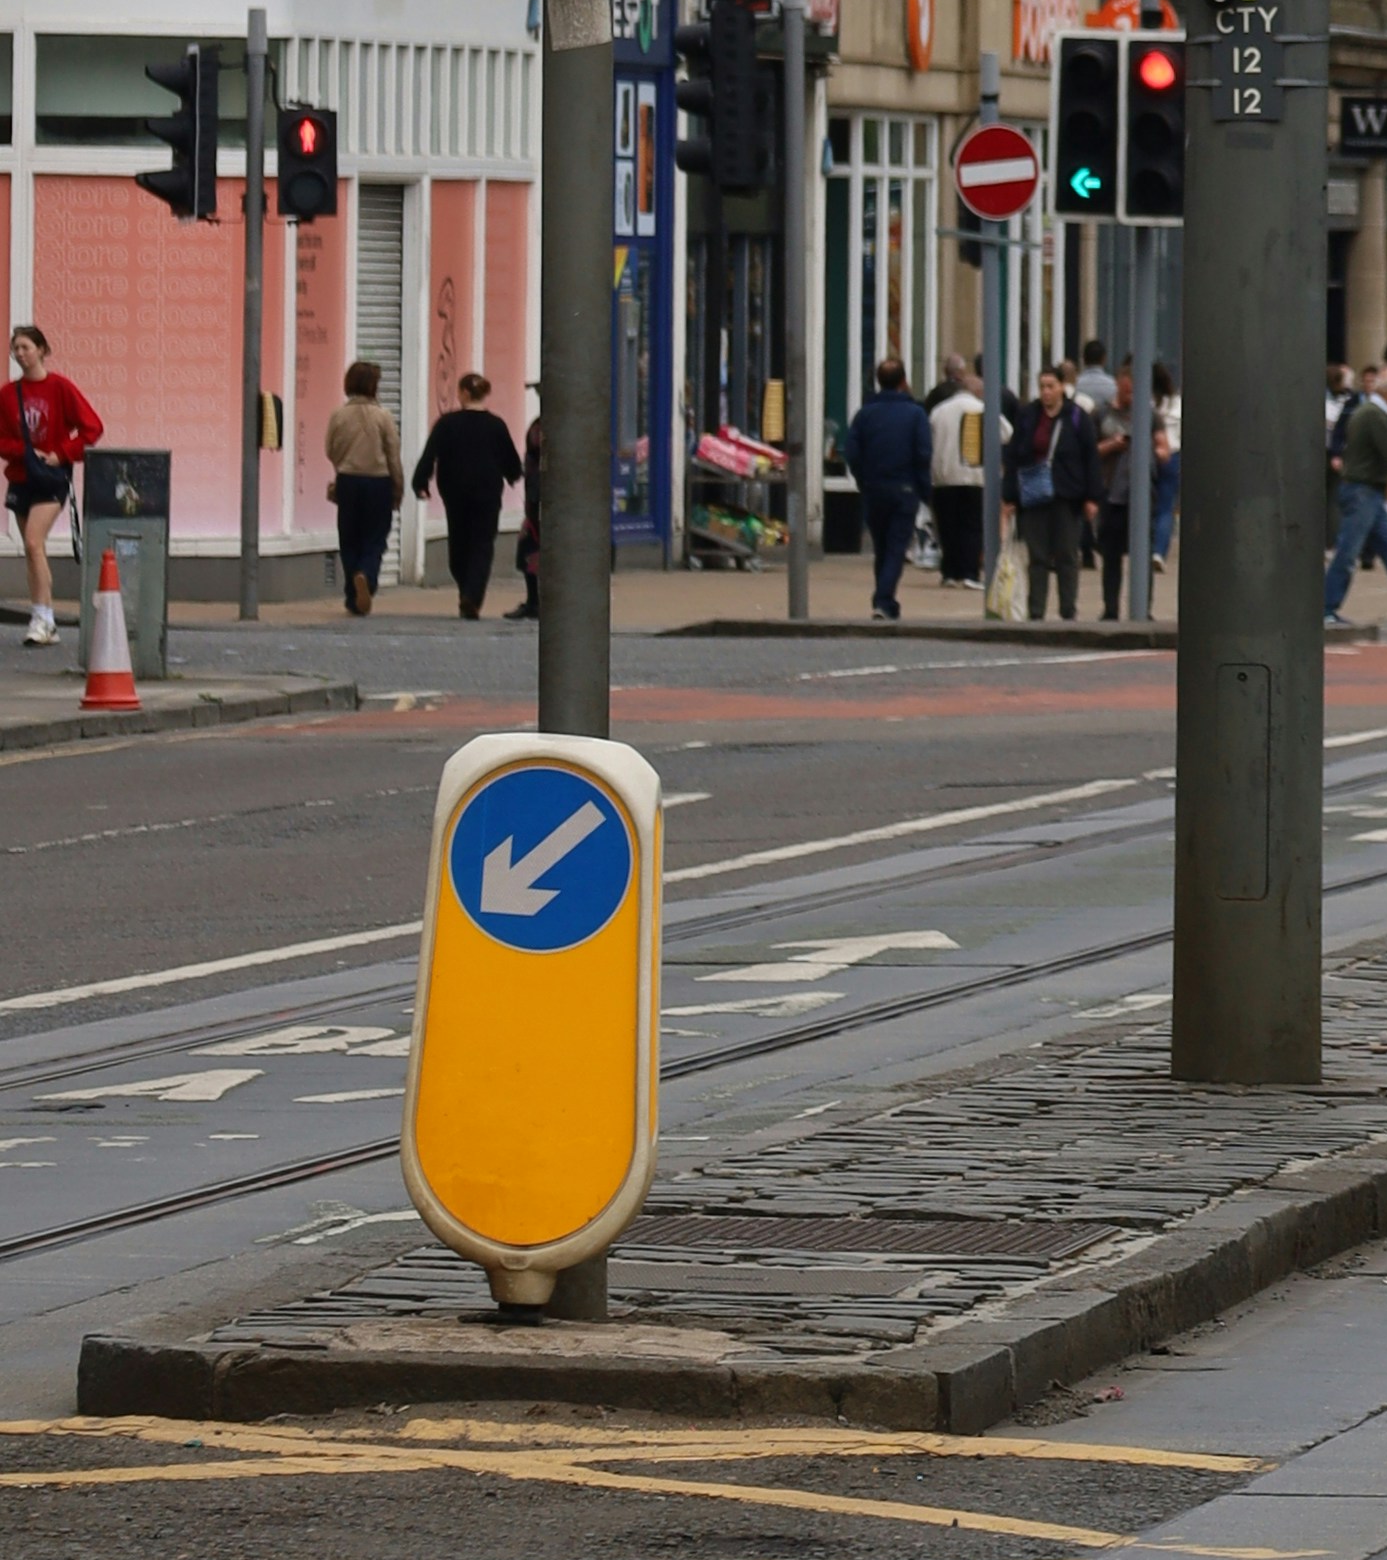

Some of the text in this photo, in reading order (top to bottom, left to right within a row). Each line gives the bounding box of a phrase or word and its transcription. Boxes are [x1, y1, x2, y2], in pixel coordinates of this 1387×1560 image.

[1216, 7, 1278, 34] CTY
[1233, 47, 1262, 74] 12
[1233, 88, 1262, 114] 12
